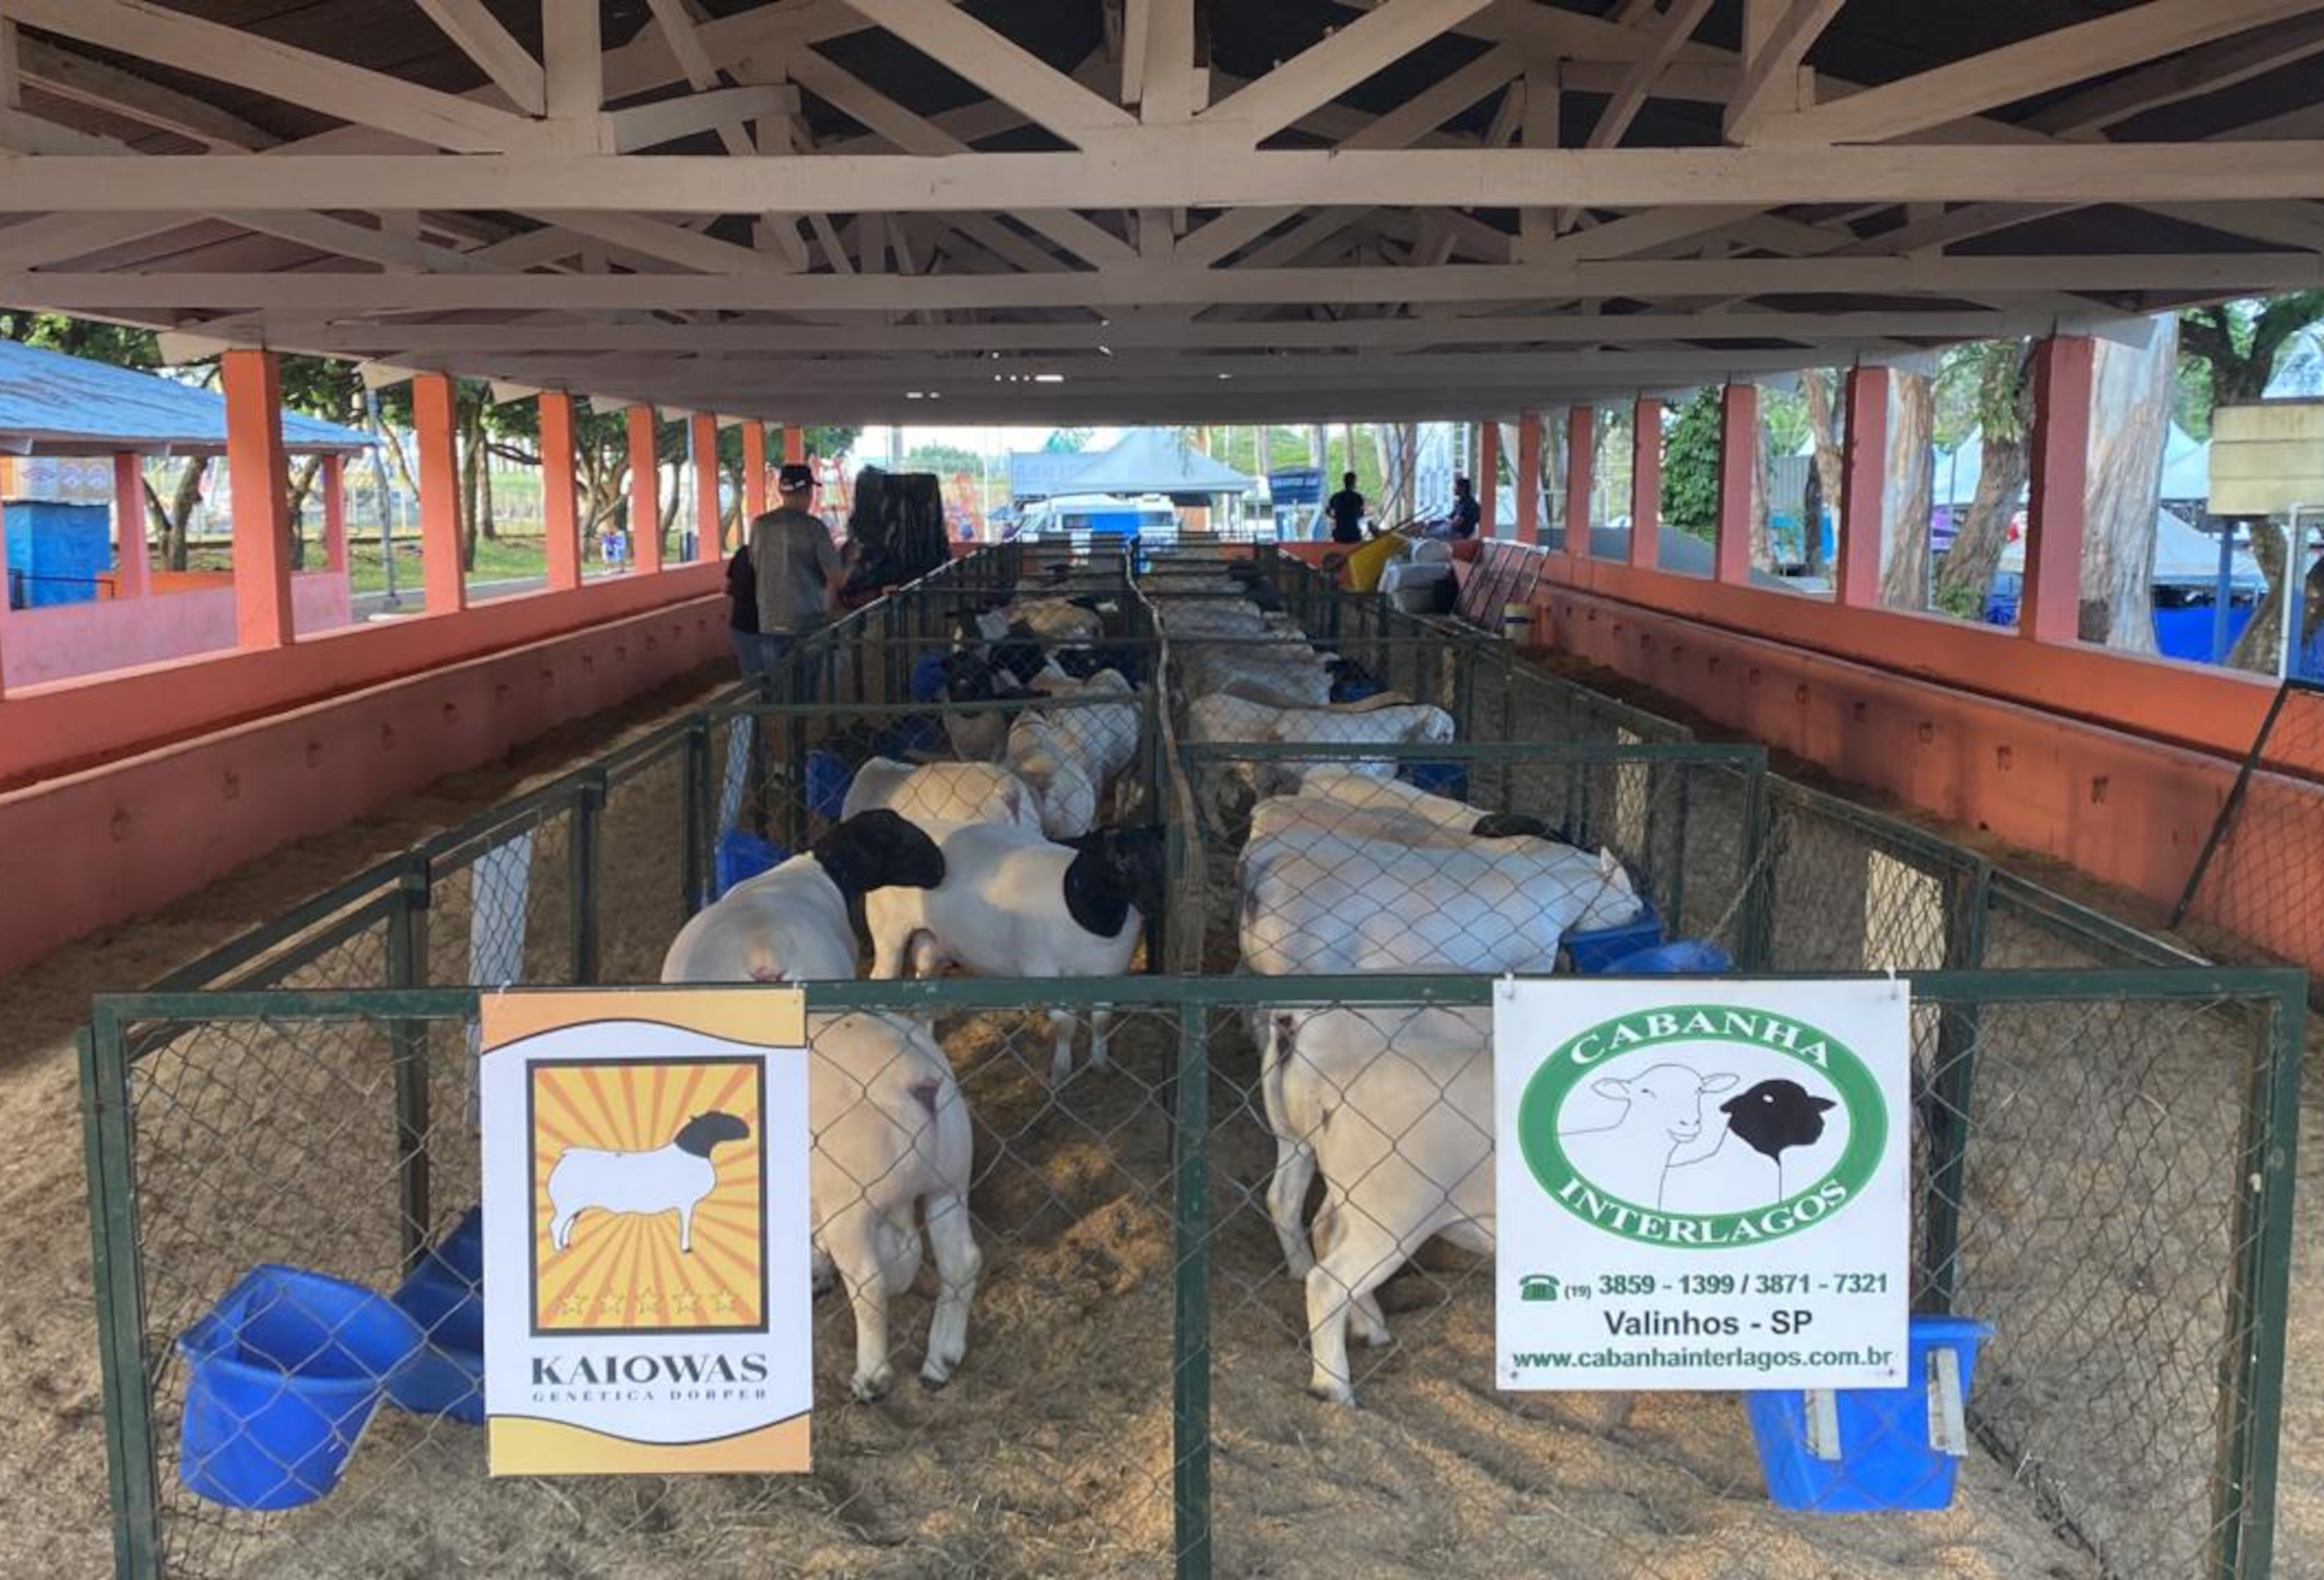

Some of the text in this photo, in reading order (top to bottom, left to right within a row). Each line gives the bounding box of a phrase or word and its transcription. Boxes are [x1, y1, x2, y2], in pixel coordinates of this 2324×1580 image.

[1570, 1010, 1830, 1068] CABANHA
[1559, 1178, 1846, 1244] INTERLAGOS
[1565, 1284, 1591, 1299] (19)
[1599, 1274, 1656, 1295] 3859
[1680, 1274, 1735, 1295] 1399
[1755, 1274, 1810, 1294] 3871
[1834, 1273, 1888, 1294] 7321
[1604, 1310, 1739, 1336] Valinhos
[1770, 1310, 1813, 1335] SP
[532, 1353, 769, 1385] KAIOWAS
[1513, 1346, 1894, 1372] www.cabanhainterlagos.com.br
[533, 1389, 766, 1402] GENÉTICA DORPER
